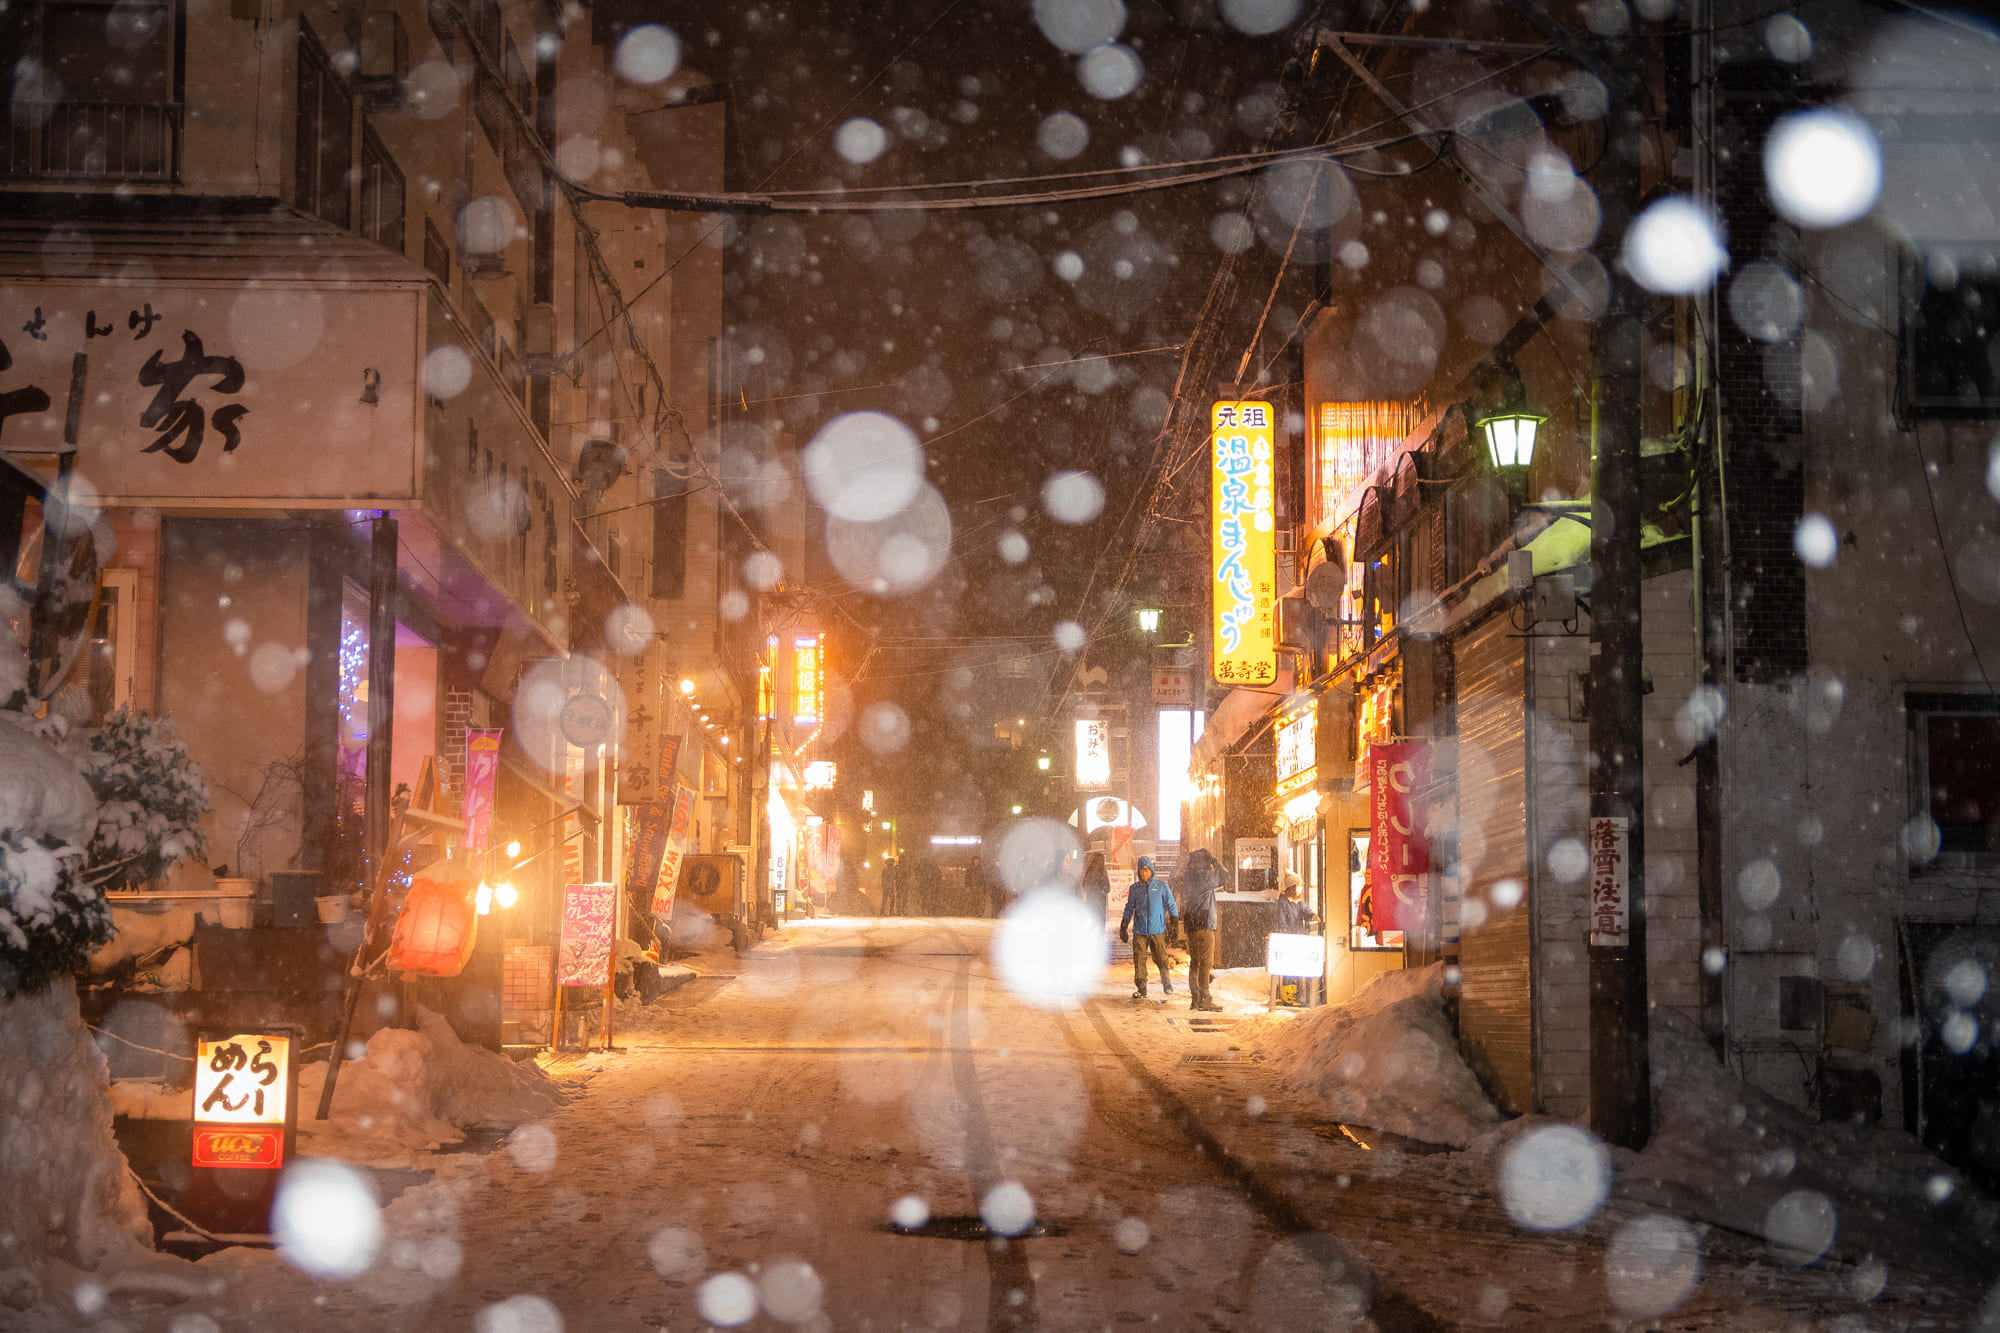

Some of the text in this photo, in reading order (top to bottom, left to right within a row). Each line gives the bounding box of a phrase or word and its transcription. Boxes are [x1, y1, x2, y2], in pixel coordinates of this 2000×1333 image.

[1217, 408, 1268, 428] 元祖
[1216, 437, 1257, 653] 温泉まんじゅう
[659, 739, 678, 779] Rental
[637, 822, 658, 888] Snowboard
[658, 794, 689, 892] HOT WAX
[1593, 819, 1623, 936] 落雪注意
